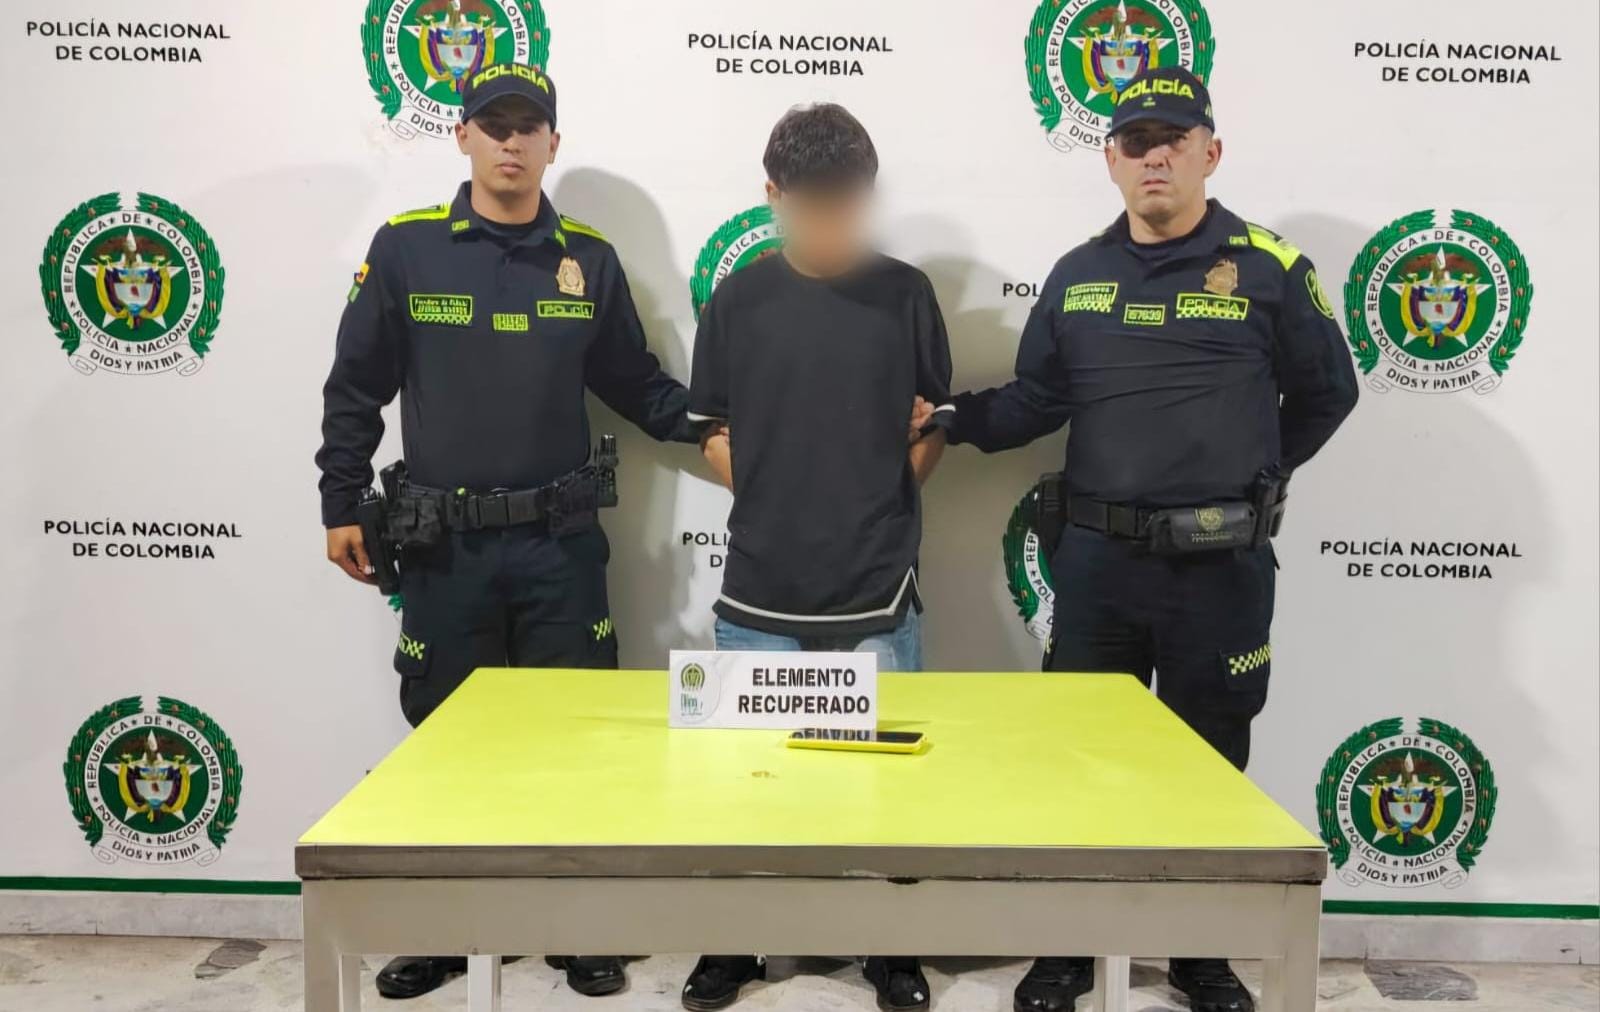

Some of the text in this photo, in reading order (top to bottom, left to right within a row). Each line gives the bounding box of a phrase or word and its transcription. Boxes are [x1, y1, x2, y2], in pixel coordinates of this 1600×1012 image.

[27, 18, 230, 39] POLICÍA NACIONAL
[689, 31, 893, 52] POLICÍA NACIONAL
[1355, 39, 1561, 61] POLICÍA NACIONAL
[56, 46, 202, 63] DE COLOMBIA
[716, 58, 864, 76] DE COLOMBIA
[1382, 67, 1530, 84] DE COLOMBIA
[410, 114, 453, 135] DIOS Y
[1069, 125, 1102, 147] DIOS
[63, 213, 203, 295] REPUBLICA DE COLOMBIA
[1367, 230, 1509, 313] REPUBLICA DE COLOMBIA
[136, 309, 198, 354] NACIONAL
[90, 349, 183, 371] DIOS Y PATRIA
[1435, 328, 1500, 372] NACIONAL
[1386, 368, 1481, 390] DIOS Y PATRIA
[44, 518, 241, 538] POLICÍA NACIONAL
[682, 531, 727, 546] POLI
[73, 543, 215, 559] DE COLOMBIA
[1321, 538, 1522, 557] POLICÍA NACIONAL
[710, 554, 723, 568] D
[1348, 563, 1492, 578] DE COLOMBIA
[752, 667, 856, 687] ELEMENTO
[738, 694, 870, 715] RECUPERADO
[87, 715, 221, 791] REPUBLICA DE COLOMBIA
[1338, 736, 1474, 812] REPUBLICA DE COLOMBIA
[157, 807, 215, 845] NACIONAL
[112, 840, 201, 861] DIOS Y PATRIA
[1404, 825, 1468, 868] NACIONAL
[1357, 862, 1449, 884] DIOS Y PATRIA
